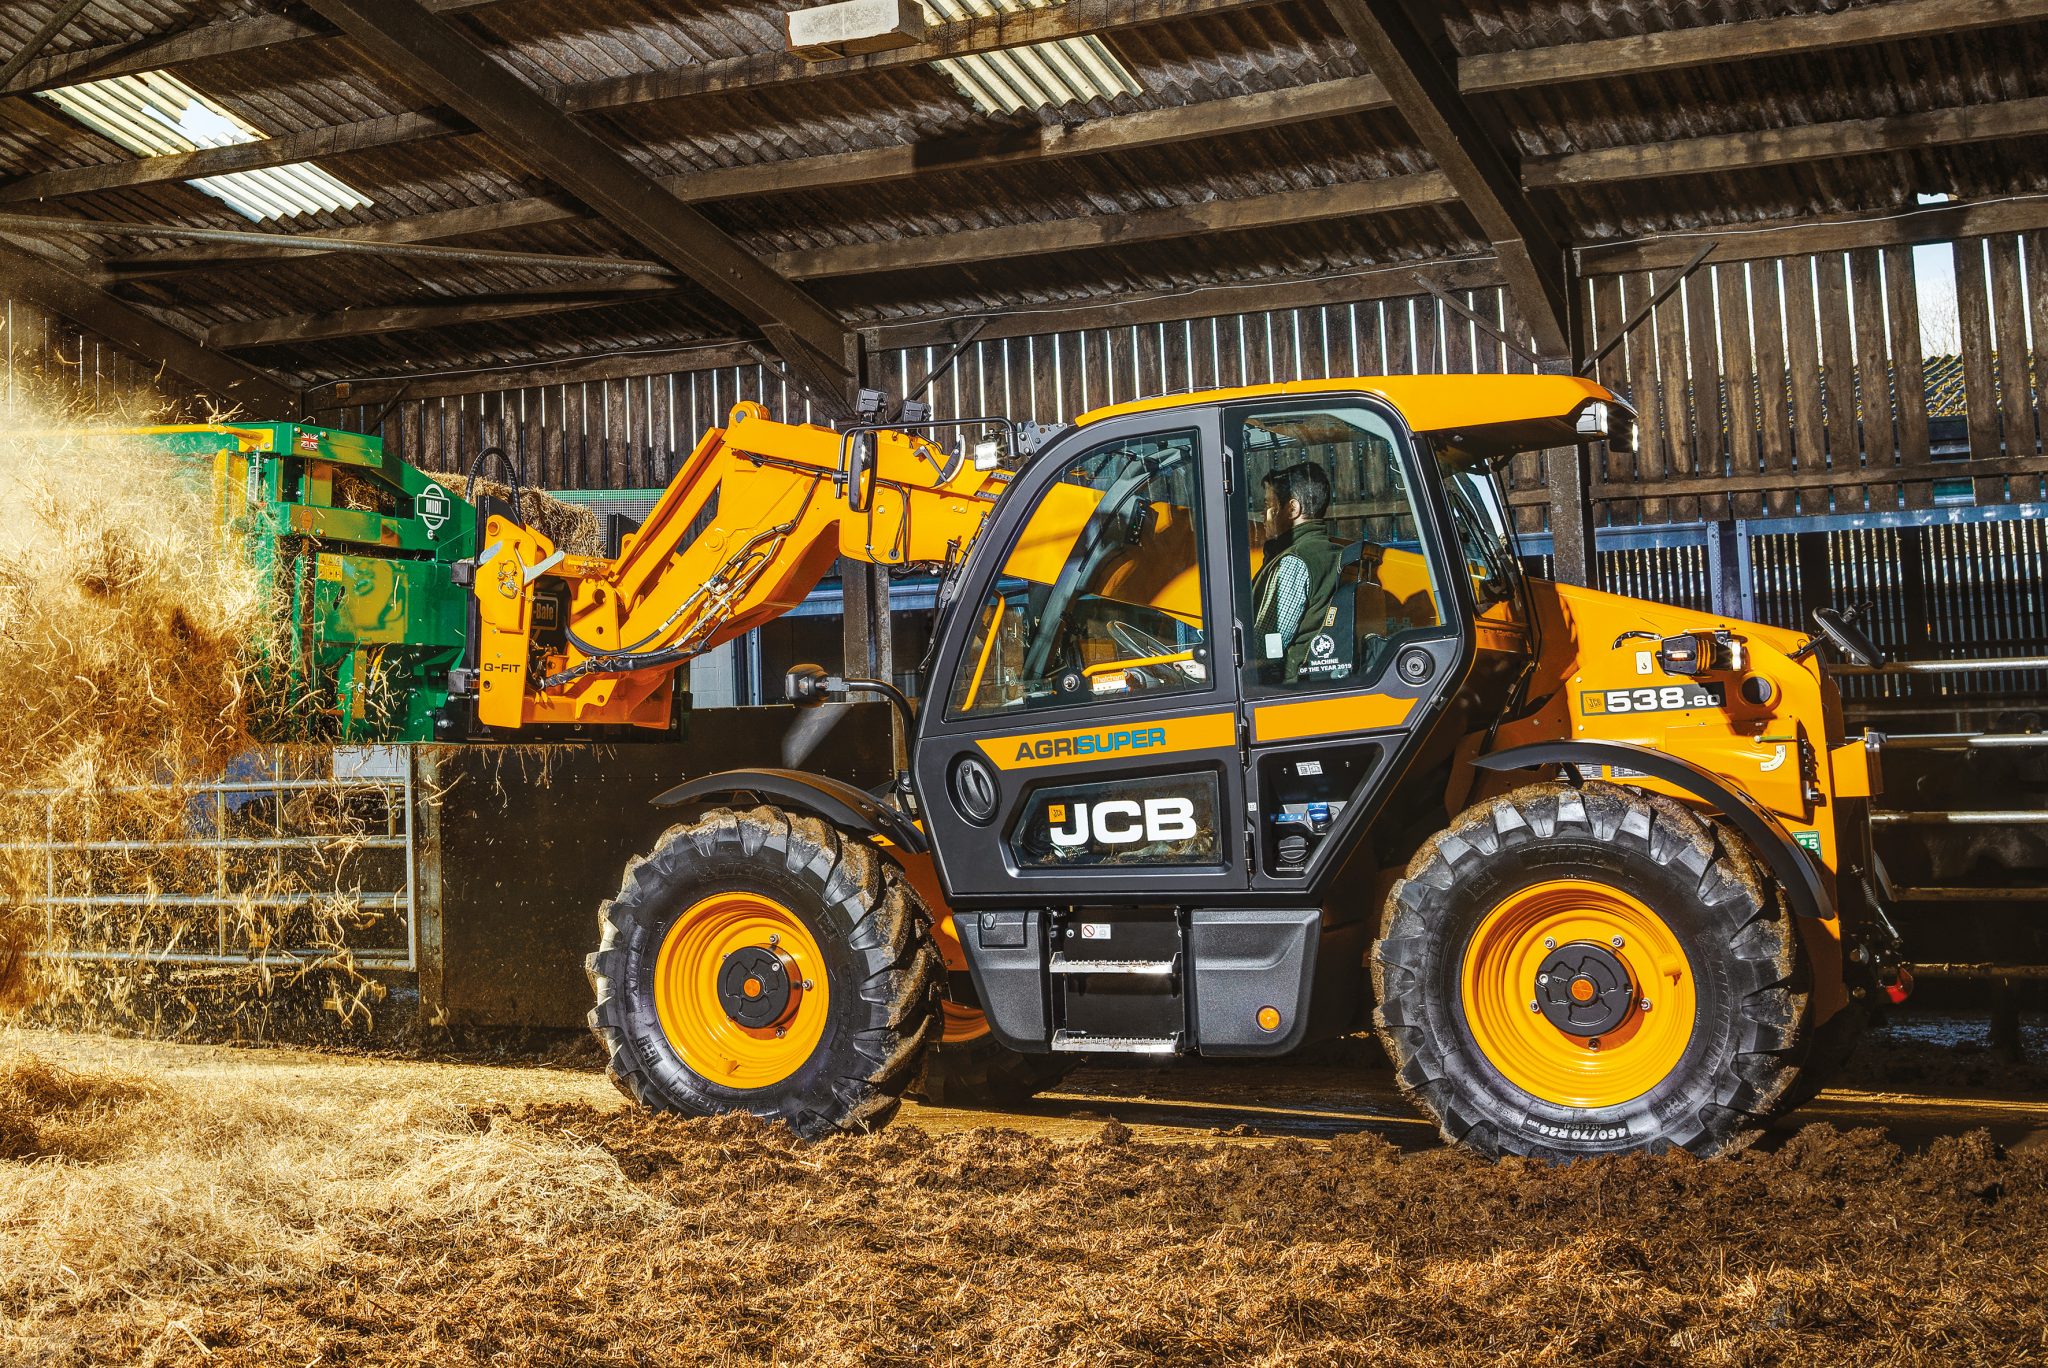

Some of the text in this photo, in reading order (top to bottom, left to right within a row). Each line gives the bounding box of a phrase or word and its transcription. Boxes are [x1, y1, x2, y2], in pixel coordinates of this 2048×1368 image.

[425, 498, 442, 515] MIDI
[483, 663, 520, 673] Q-FIT
[1311, 658, 1339, 666] MACHINE
[1015, 727, 1166, 761] AGRISUPER
[1049, 797, 1197, 846] JCB
[1808, 838, 1818, 850] 5
[1571, 1128, 1627, 1140] 460/70
